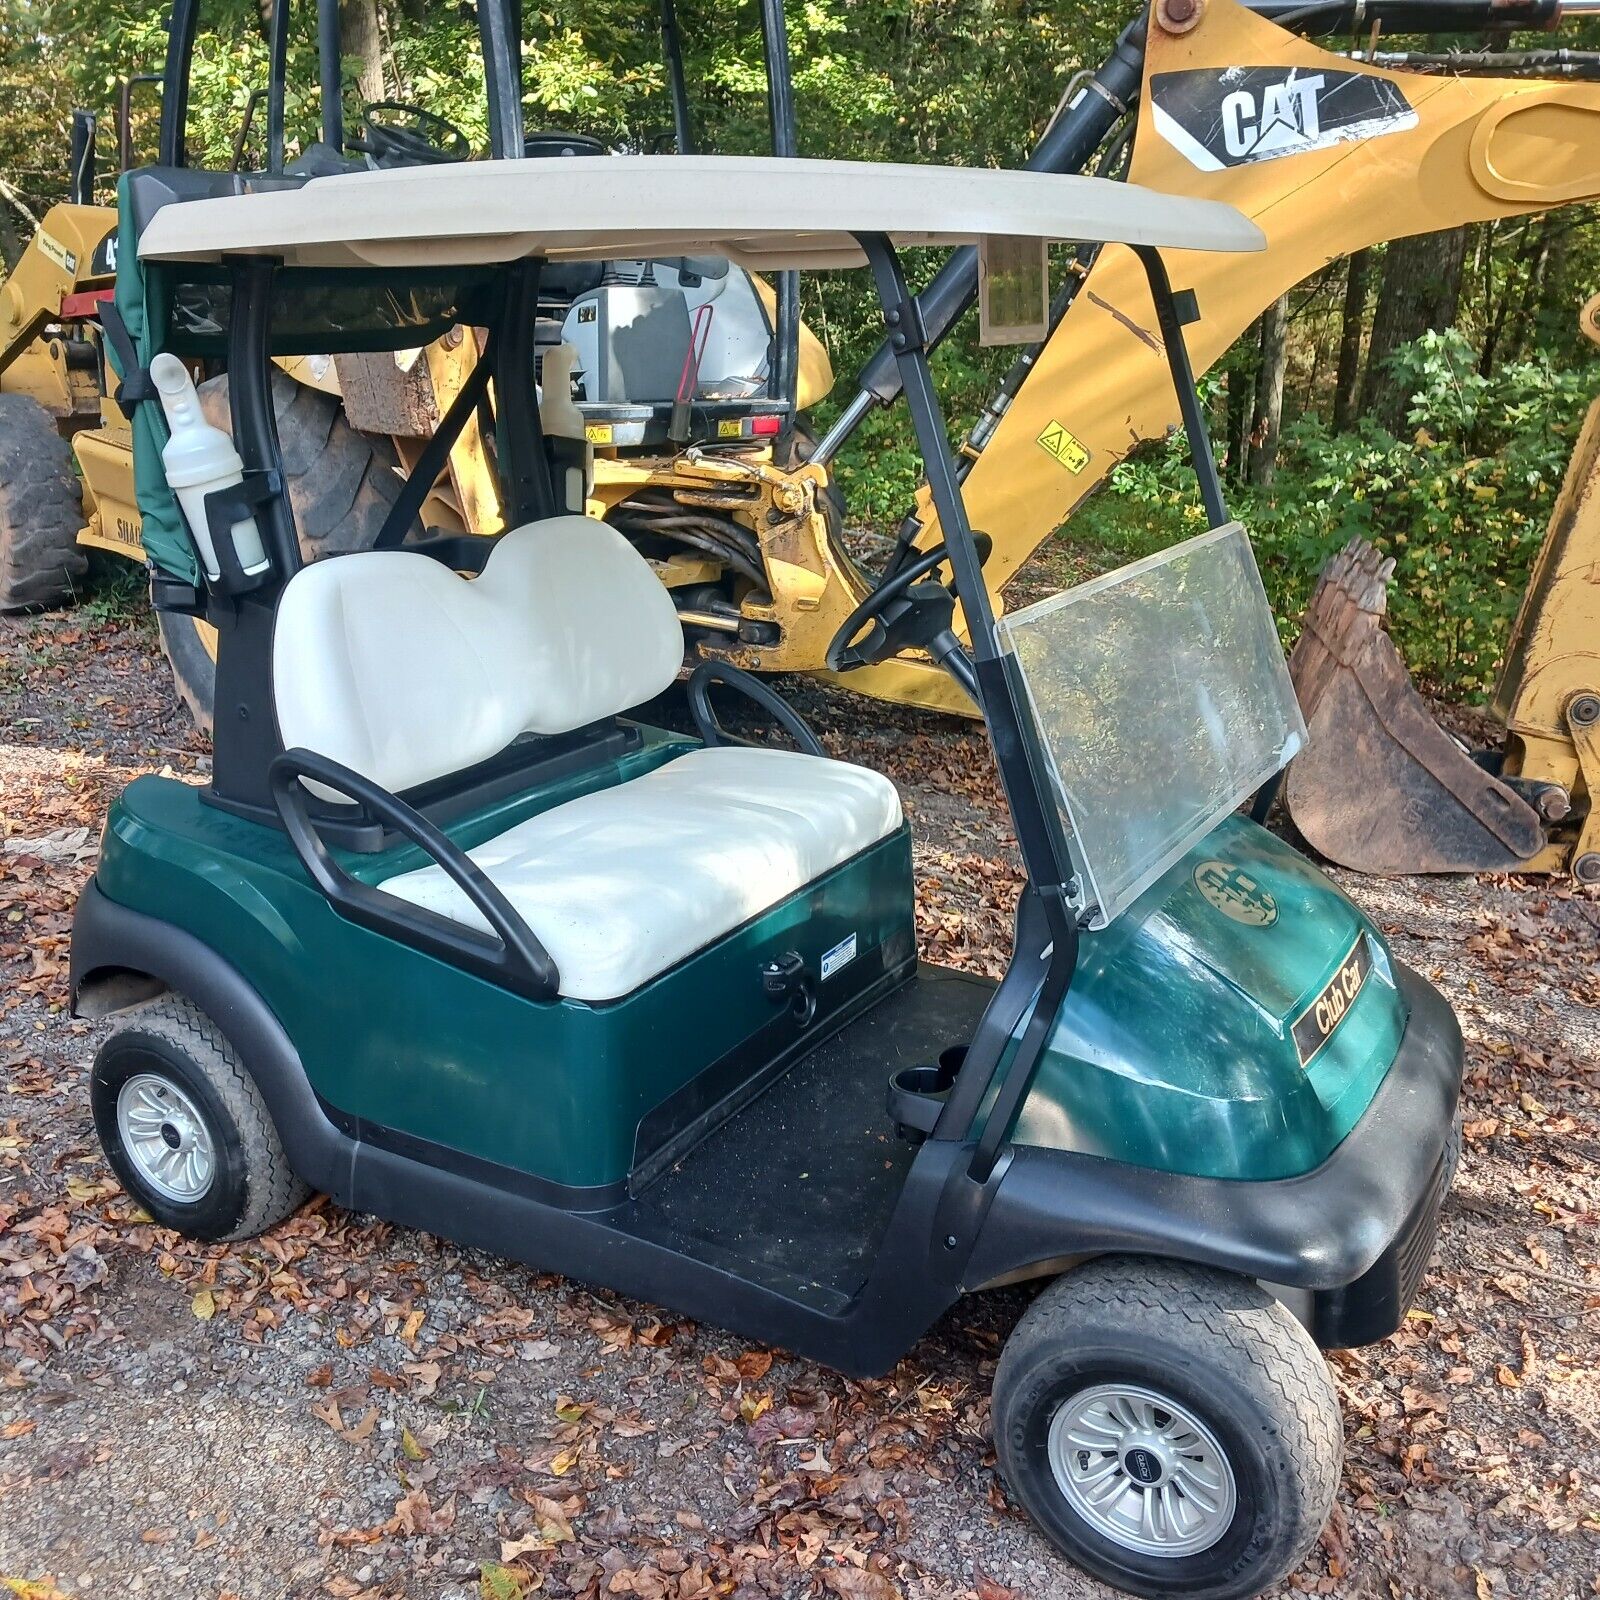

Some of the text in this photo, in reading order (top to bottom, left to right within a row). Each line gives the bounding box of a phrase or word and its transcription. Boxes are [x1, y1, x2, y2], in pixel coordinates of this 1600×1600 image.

[1221, 74, 1325, 158] CAT
[1315, 960, 1362, 1035] Club Car
